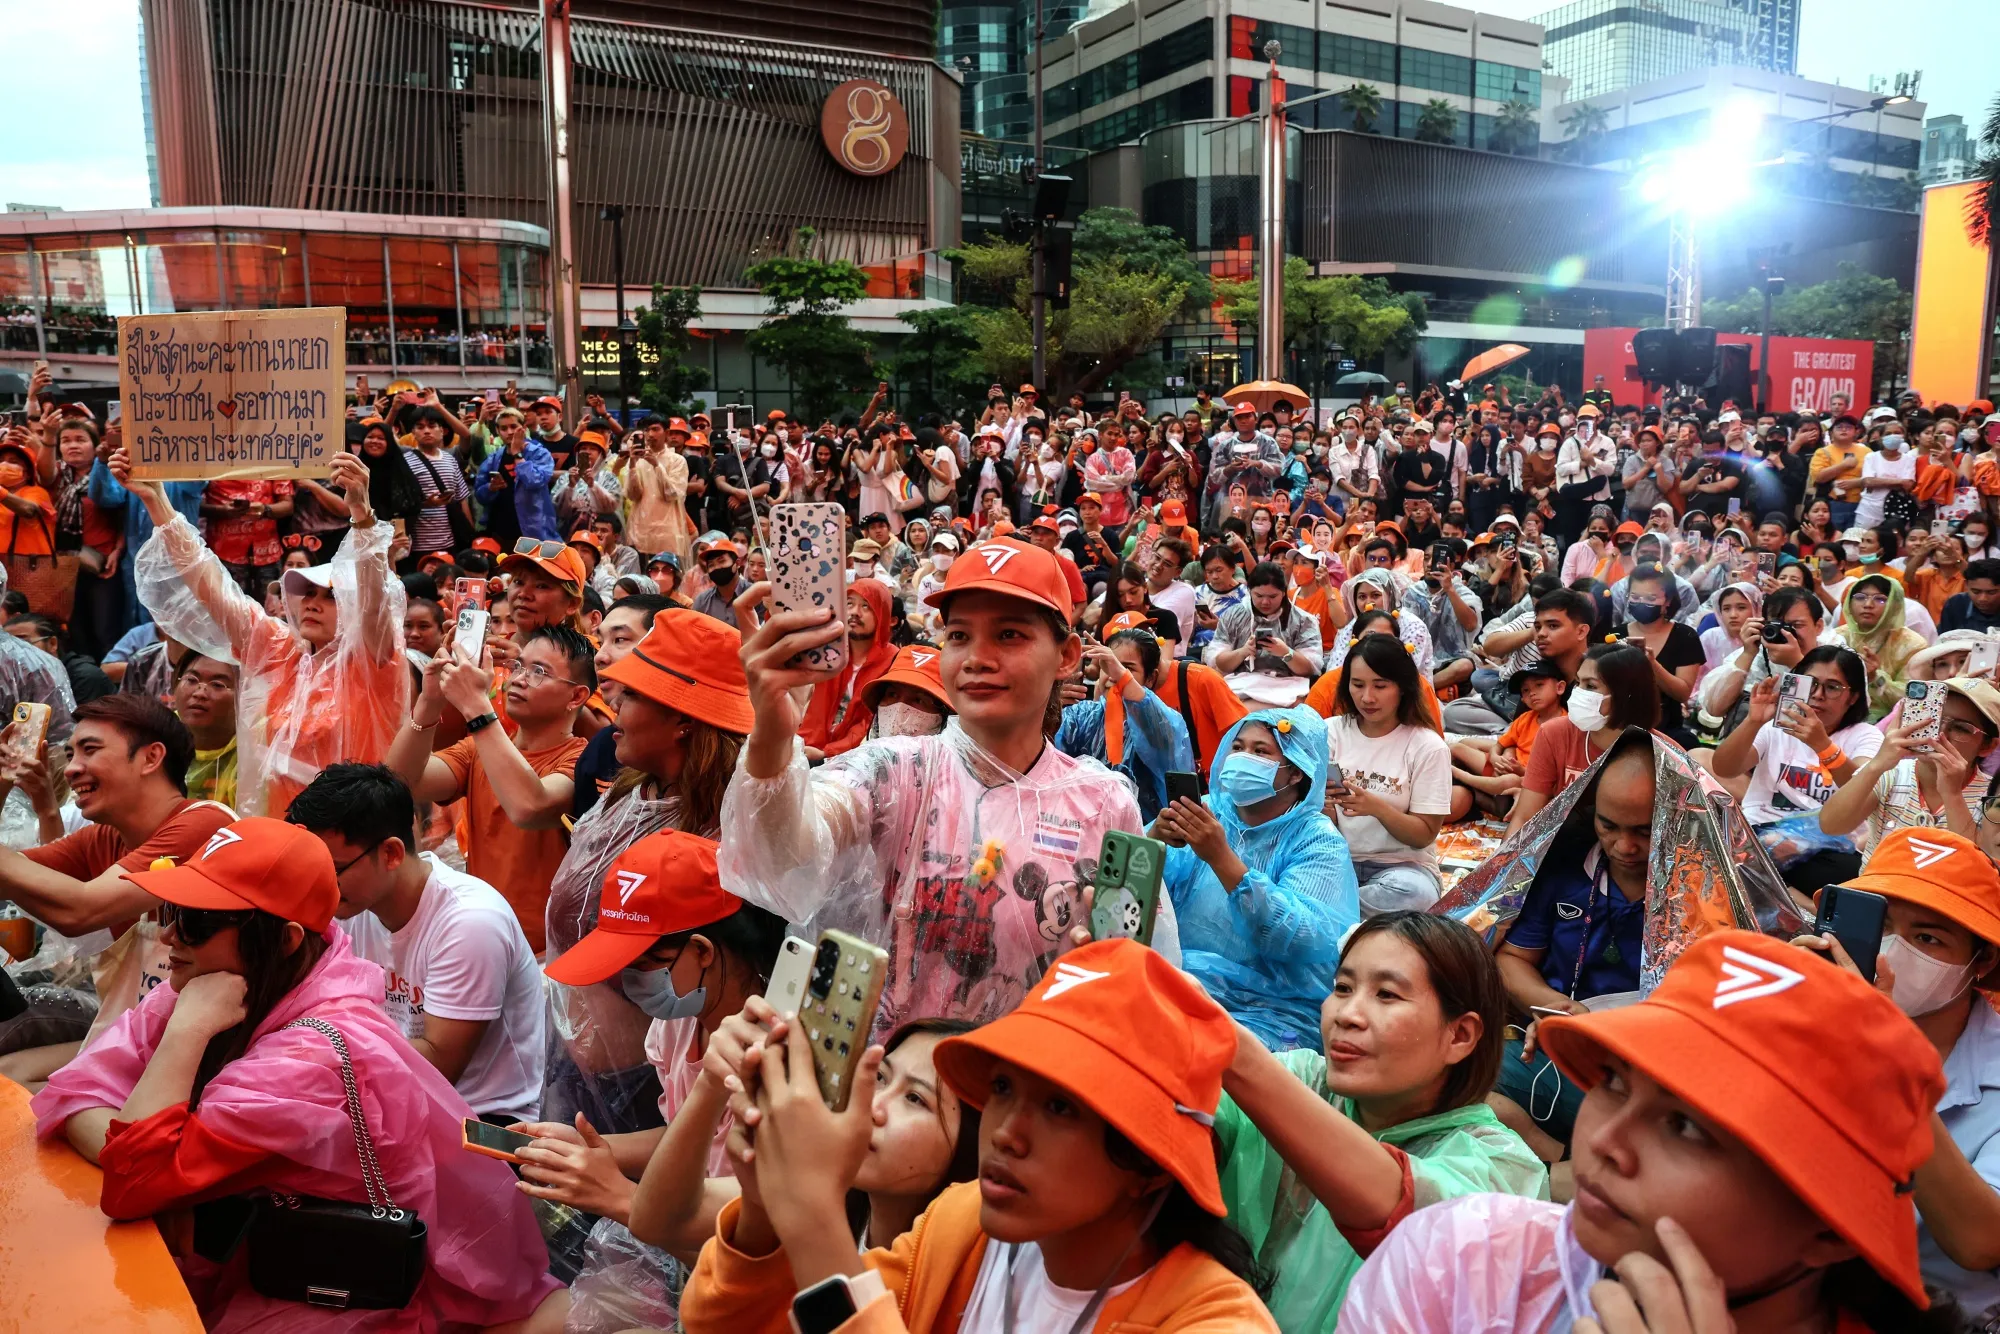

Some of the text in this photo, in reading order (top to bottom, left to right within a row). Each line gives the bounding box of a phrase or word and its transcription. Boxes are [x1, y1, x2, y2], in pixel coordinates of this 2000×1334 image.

[126, 327, 329, 386] สู้ให้สุดนะคะท่านนายก
[1793, 351, 1857, 371] THE GREATEST
[129, 378, 327, 422] ประชาชน รอท่านมา
[1790, 376, 1856, 412] GRAND
[137, 420, 325, 468] บริหารประเทศอยู่ค่ะ
[601, 907, 651, 923] พรรคก้าวไกล
